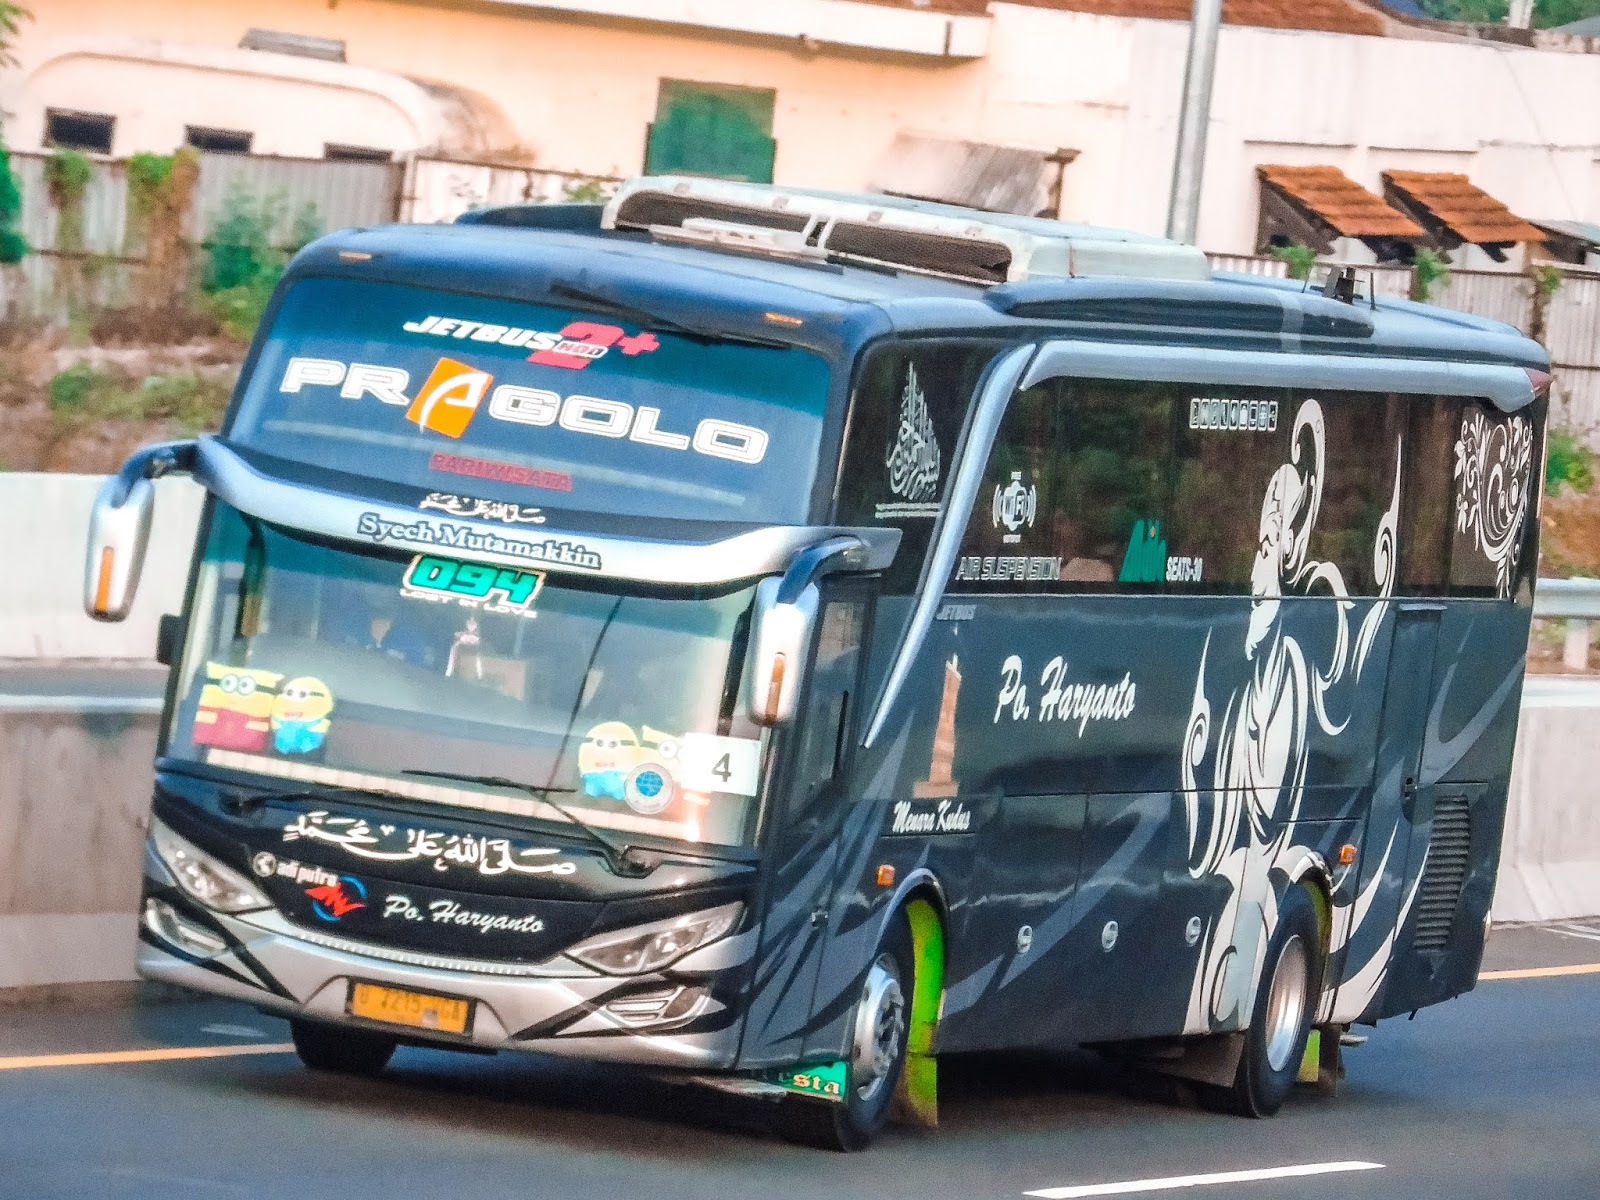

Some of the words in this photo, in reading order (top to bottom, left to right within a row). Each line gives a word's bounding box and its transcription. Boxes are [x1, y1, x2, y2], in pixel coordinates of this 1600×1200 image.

[402, 316, 563, 350] JETBUS
[279, 356, 769, 464] PRAGOLO
[358, 512, 437, 542] Syech
[437, 522, 602, 570] Mutamakkin
[409, 557, 540, 604] 094
[1039, 655, 1136, 738] Haryanto
[711, 752, 732, 783] 4
[382, 894, 423, 921] Po.
[428, 900, 545, 934] Haryanto
